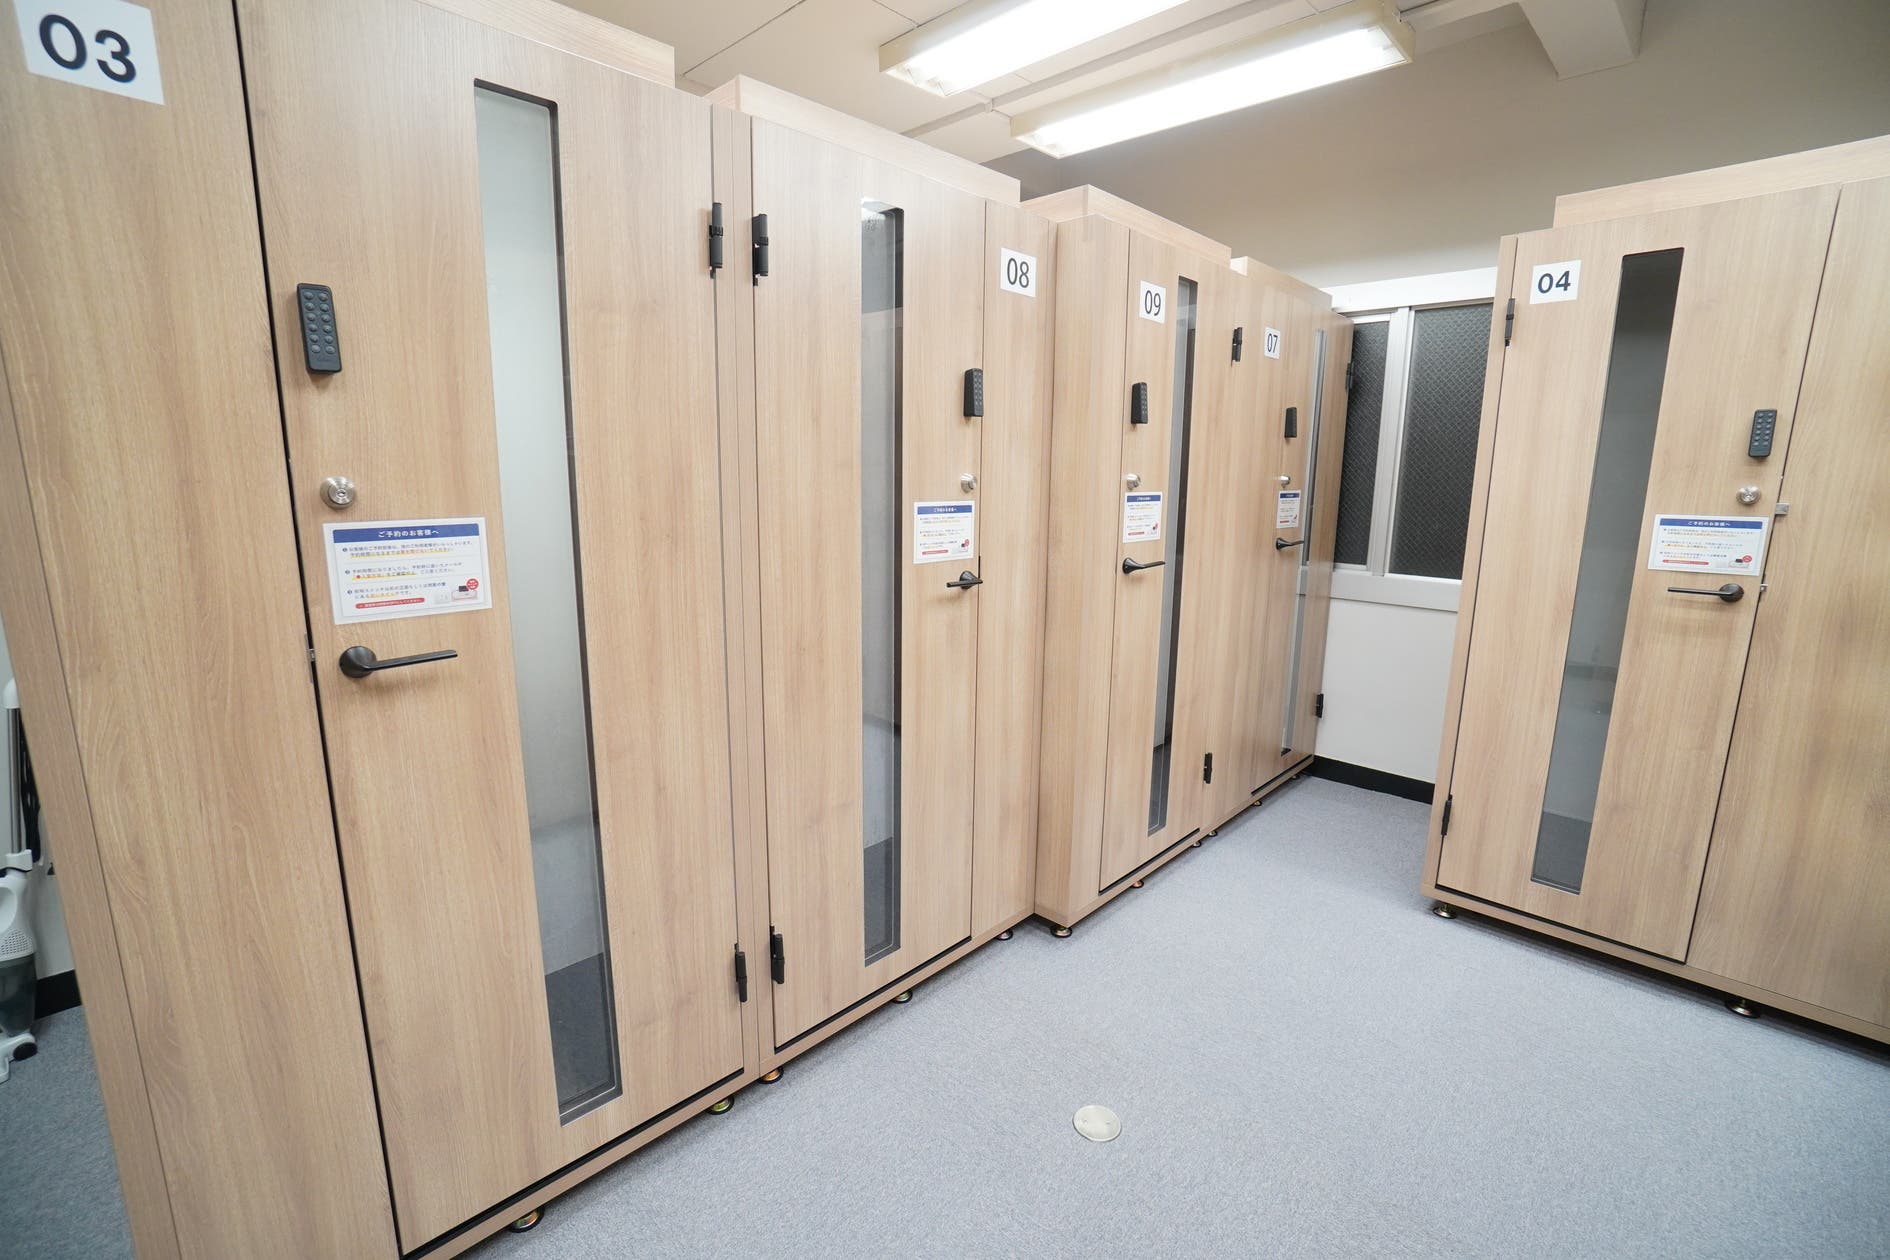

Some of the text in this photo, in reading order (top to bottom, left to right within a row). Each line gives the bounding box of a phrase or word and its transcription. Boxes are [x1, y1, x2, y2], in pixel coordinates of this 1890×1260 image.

[39, 14, 137, 83] 03
[1007, 257, 1029, 288] 08
[1538, 270, 1571, 294] 04
[1145, 290, 1161, 316] 09
[1267, 333, 1278, 353] 07
[378, 529, 440, 538] ご予約のお客様へ
